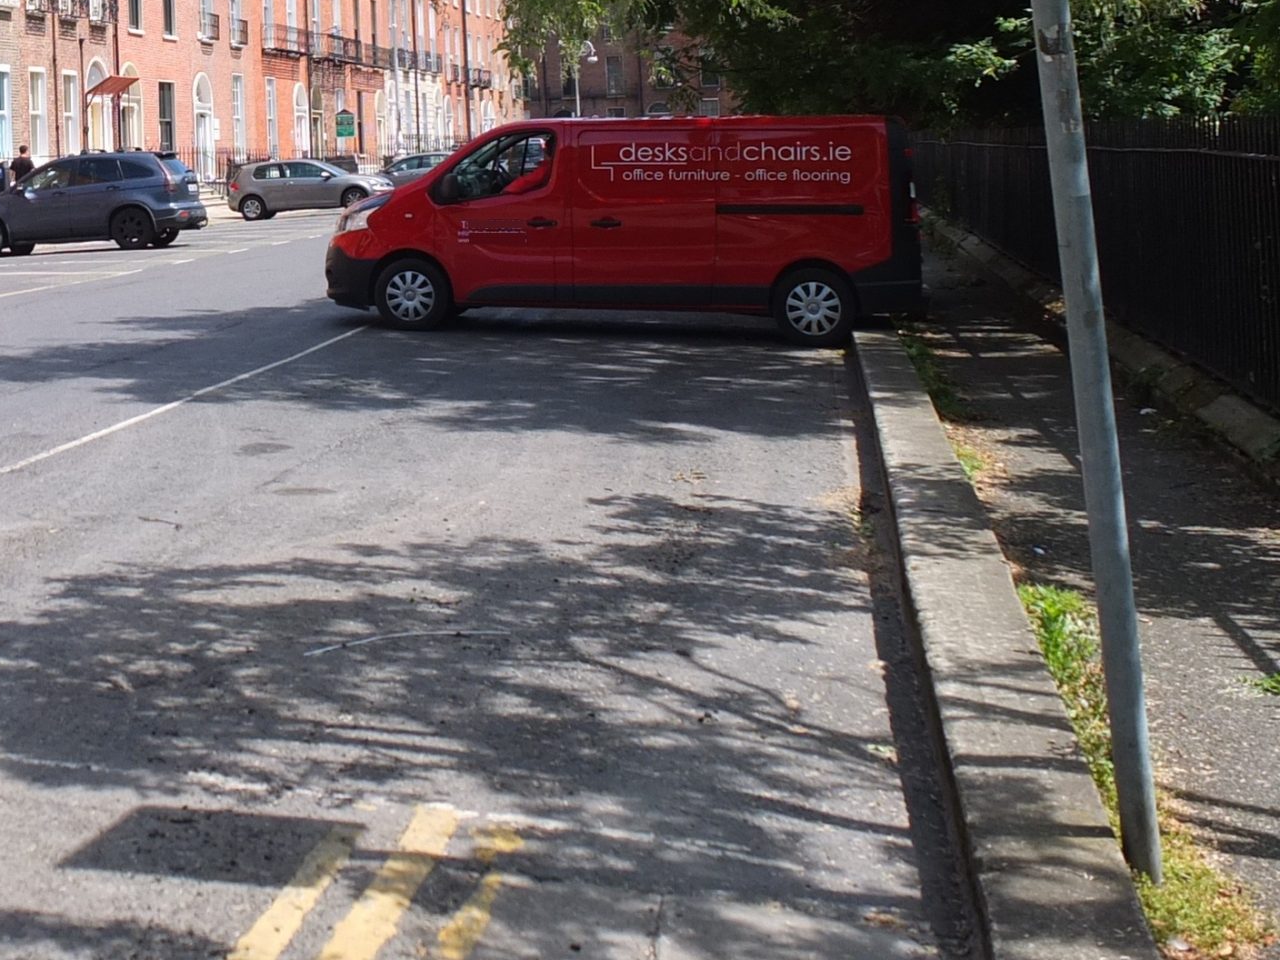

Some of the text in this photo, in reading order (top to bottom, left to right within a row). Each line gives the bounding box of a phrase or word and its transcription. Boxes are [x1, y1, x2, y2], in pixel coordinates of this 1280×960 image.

[619, 141, 852, 161] desksandchairs.ie
[622, 168, 664, 181] office
[668, 168, 731, 181] furniture
[744, 168, 788, 181] office
[792, 168, 851, 184] flooring
